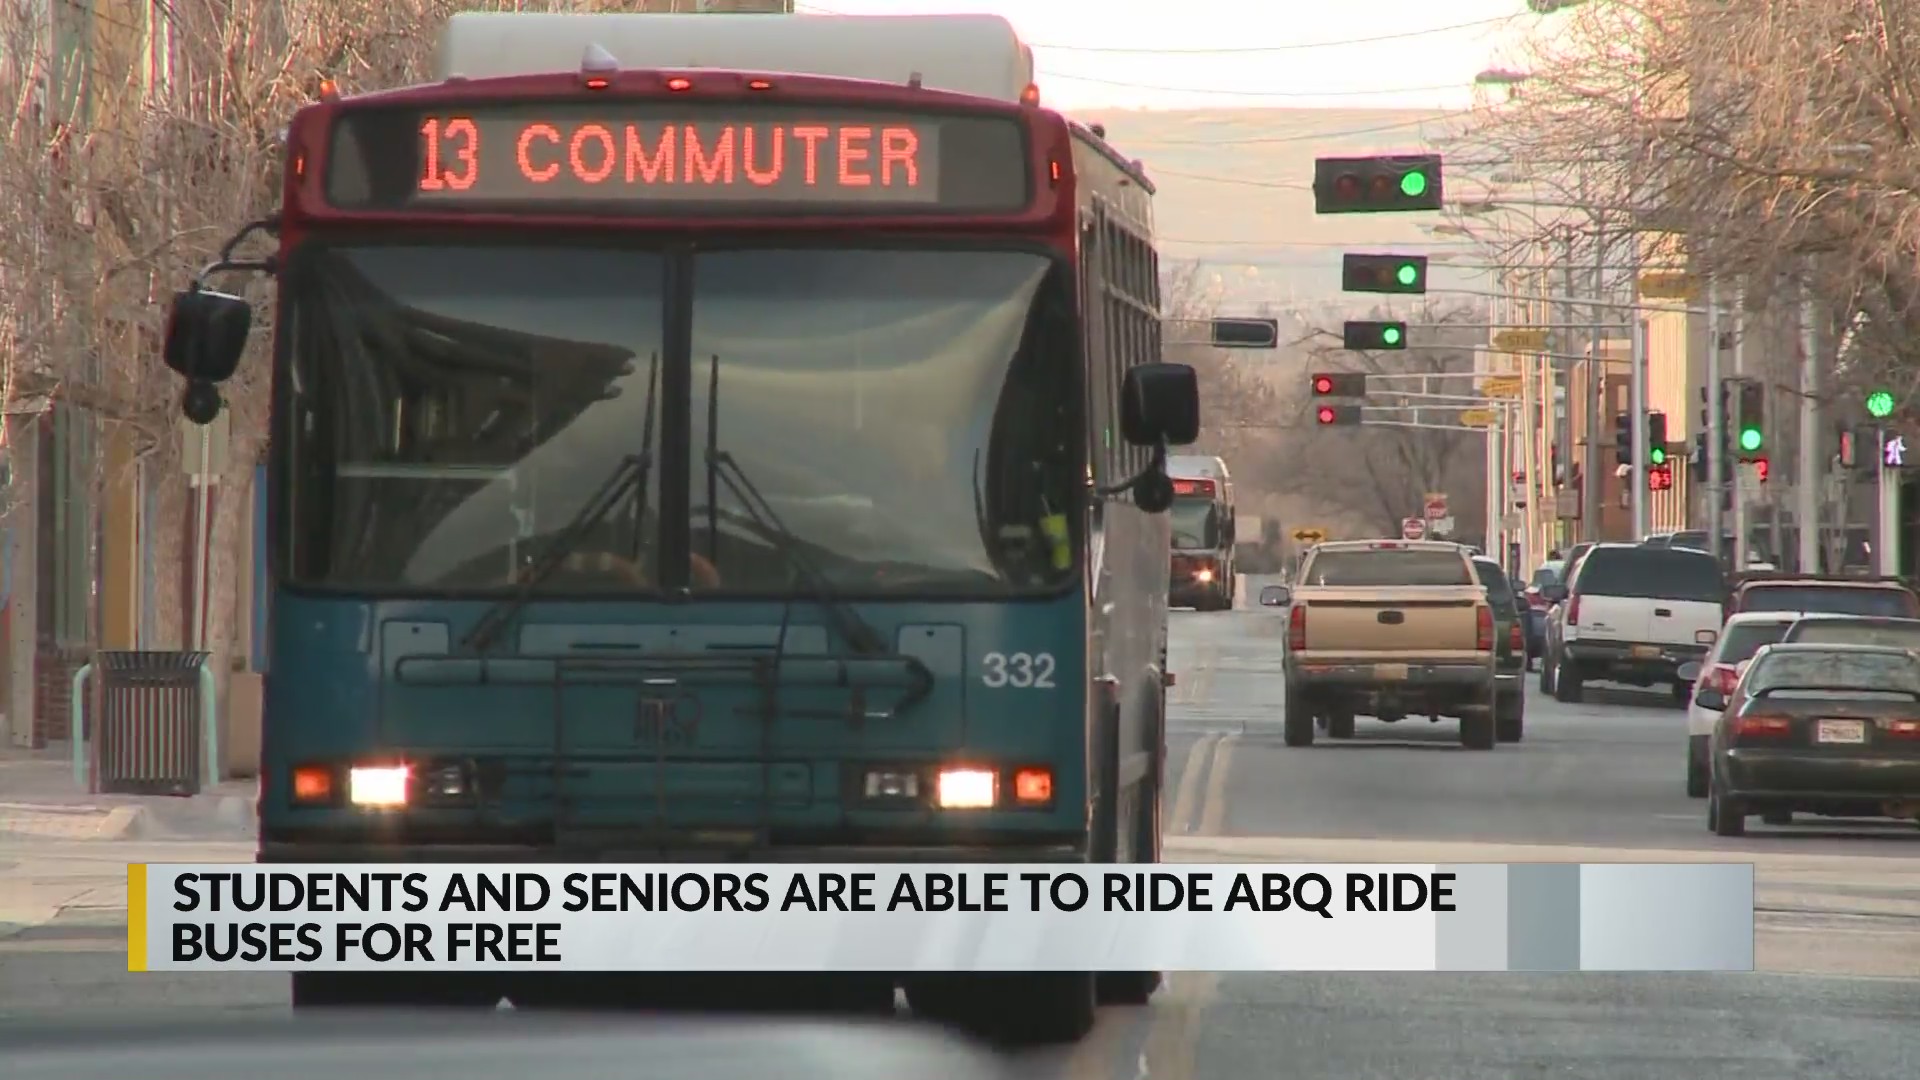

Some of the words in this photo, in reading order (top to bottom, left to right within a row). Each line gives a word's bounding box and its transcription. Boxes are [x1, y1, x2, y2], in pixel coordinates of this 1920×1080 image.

[419, 117, 478, 191] 13
[516, 123, 919, 187] COMMUTER
[982, 652, 1057, 689] 332
